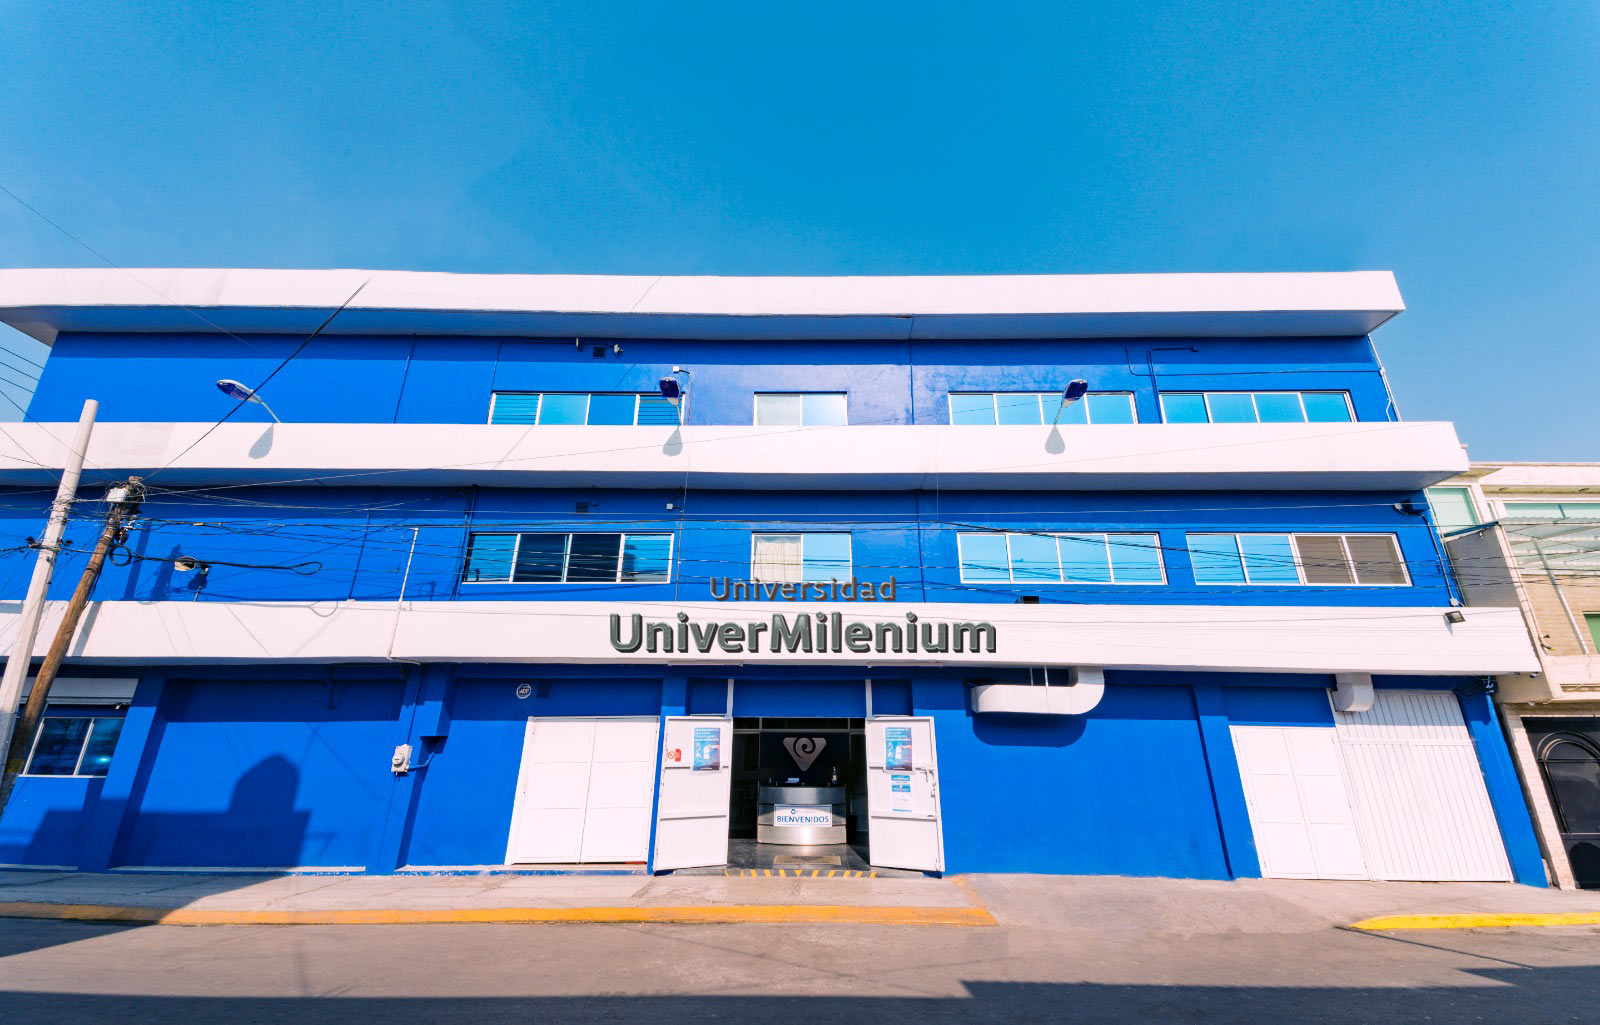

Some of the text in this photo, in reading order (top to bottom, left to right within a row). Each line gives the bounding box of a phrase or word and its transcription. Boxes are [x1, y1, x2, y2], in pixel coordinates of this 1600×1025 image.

[710, 575, 896, 601] Universidad
[609, 611, 997, 654] UniverMilenium
[776, 815, 830, 823] BIENVENIDOS
